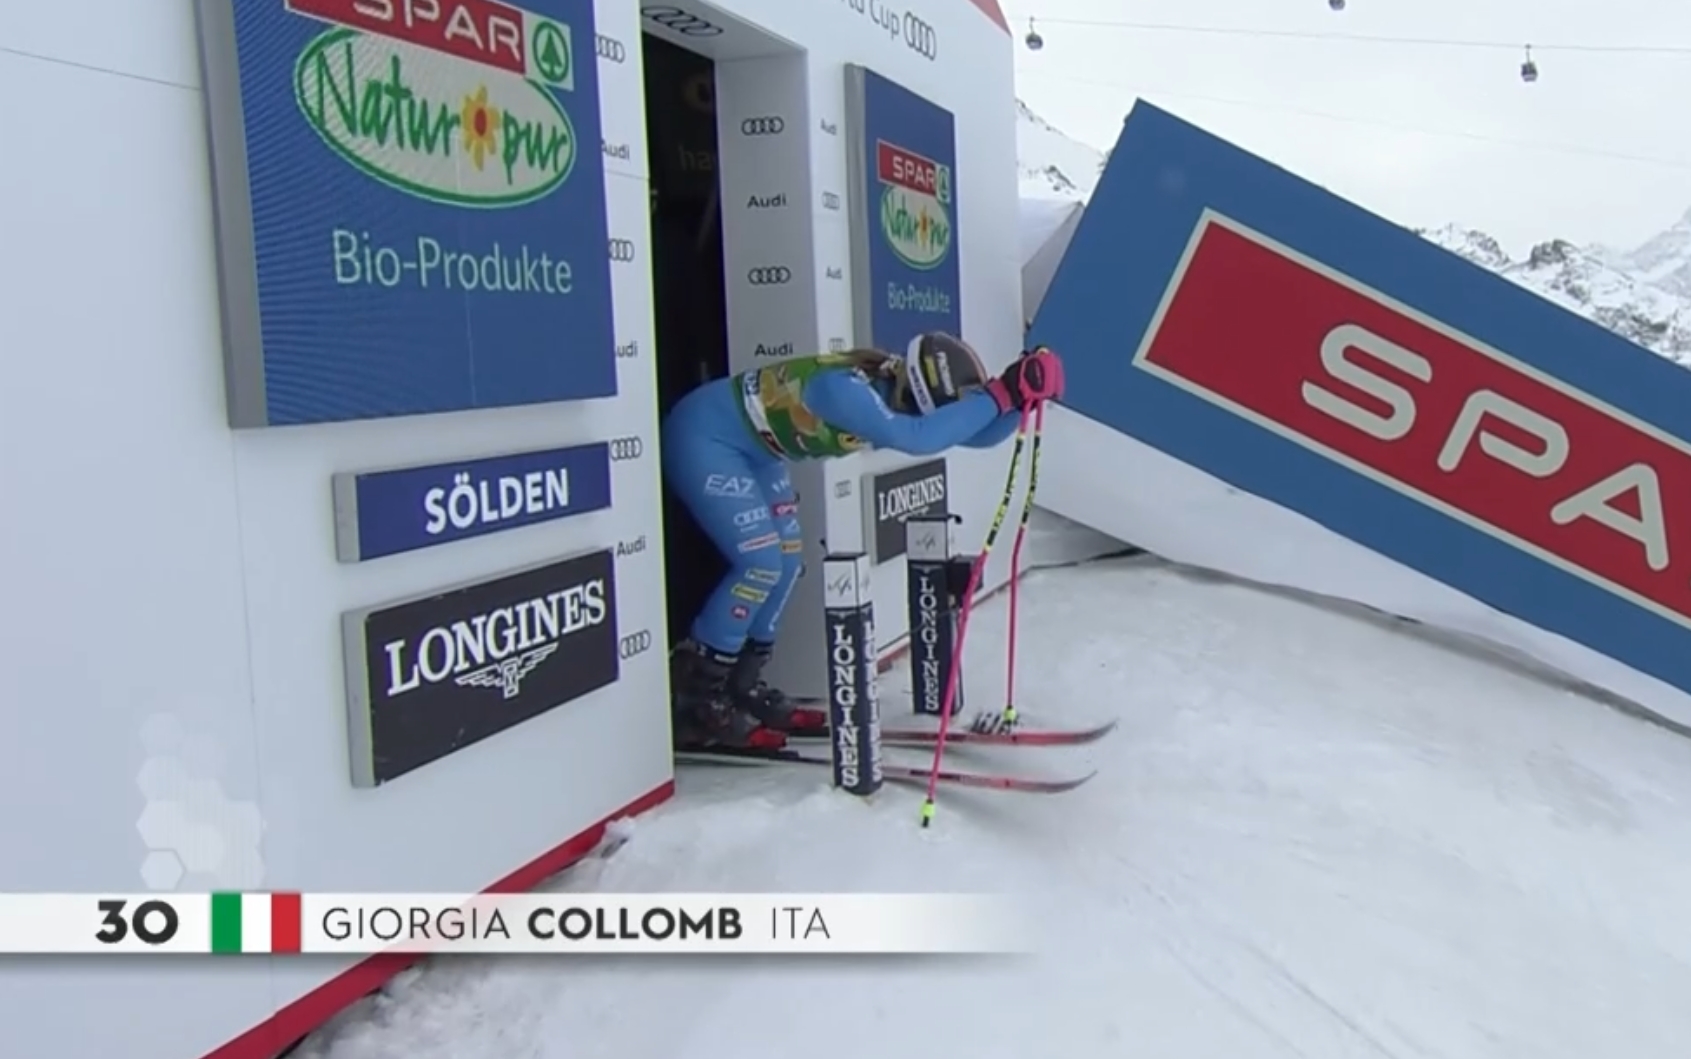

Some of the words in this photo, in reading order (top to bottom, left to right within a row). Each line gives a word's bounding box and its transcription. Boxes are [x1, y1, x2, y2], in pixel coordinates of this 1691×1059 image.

[307, 42, 461, 158] Natur
[503, 108, 569, 185] pur
[892, 155, 935, 190] SPAR
[747, 193, 787, 209] Audi
[332, 228, 573, 294] Bio-Produkte
[887, 282, 951, 314] Bio-Produkte
[615, 340, 639, 359] udi
[755, 343, 794, 358] Audi
[425, 467, 569, 535] SÖLDEN
[704, 473, 756, 497] EA7
[878, 473, 945, 521] LONGINES
[617, 535, 646, 556] Audi
[384, 578, 607, 697] LONGINES
[919, 576, 940, 711] LONGINES
[833, 624, 860, 787] LONGINES
